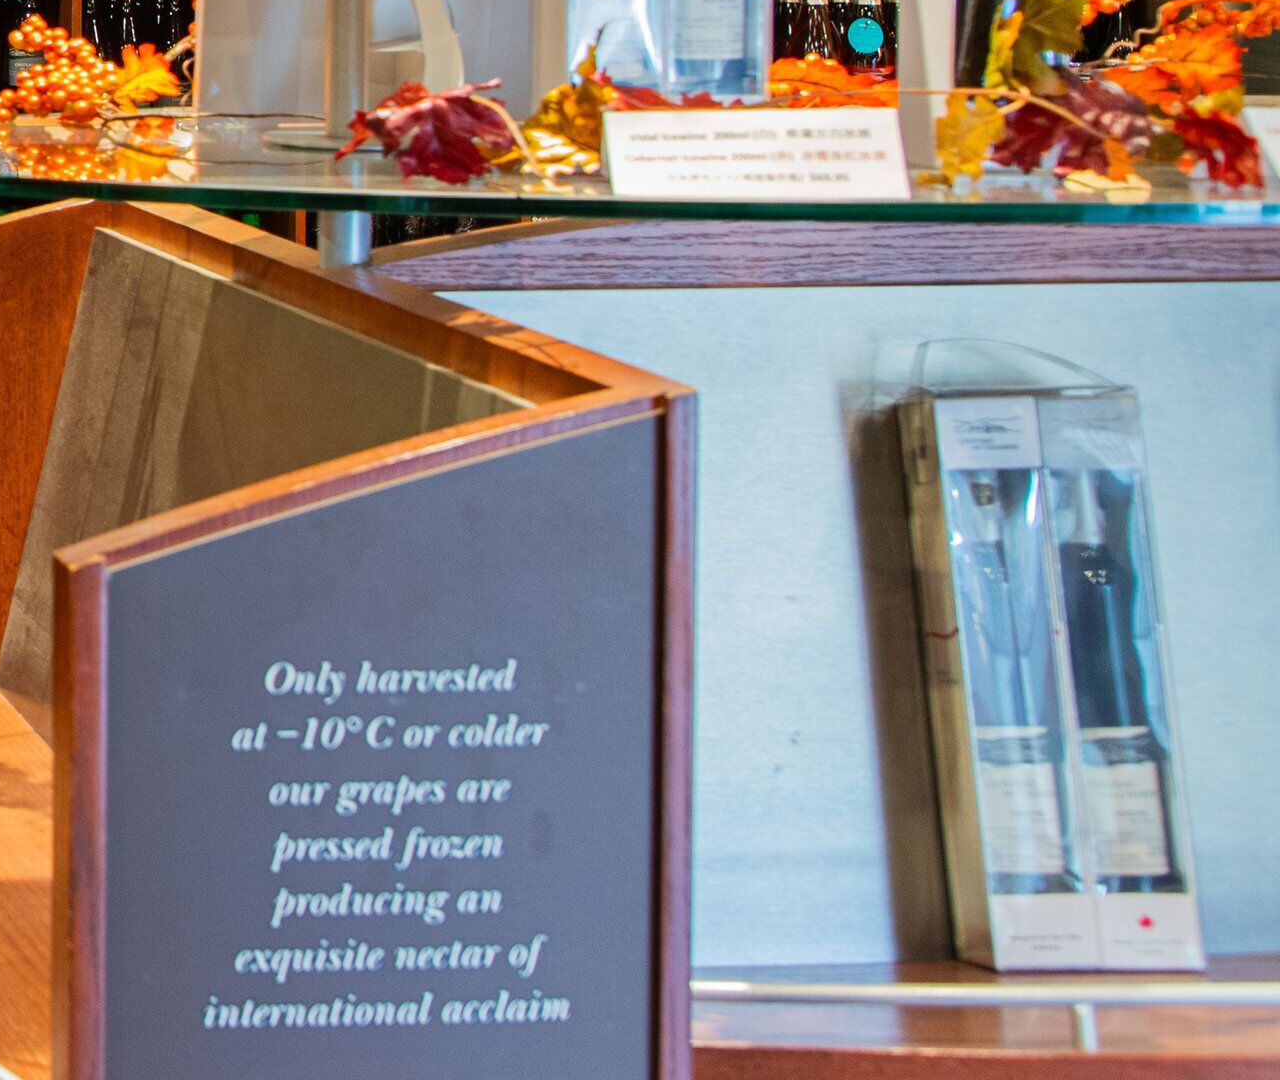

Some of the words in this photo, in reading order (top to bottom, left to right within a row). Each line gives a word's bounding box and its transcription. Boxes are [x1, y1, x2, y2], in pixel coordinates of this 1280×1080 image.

[263, 660, 346, 704] Only
[355, 658, 517, 694] harvested
[231, 721, 268, 751] at
[402, 722, 441, 748] or
[447, 713, 549, 748] colder
[268, 780, 331, 807] our
[335, 774, 446, 816] grapes
[456, 777, 512, 804] are
[270, 826, 394, 873] pressed
[395, 825, 504, 871] frozen
[270, 882, 449, 929] producing
[456, 887, 503, 914] an
[233, 938, 385, 984] exquisite
[394, 939, 502, 970] nectar
[507, 933, 548, 978] of
[203, 992, 433, 1029] international
[441, 988, 571, 1024] acclaim
